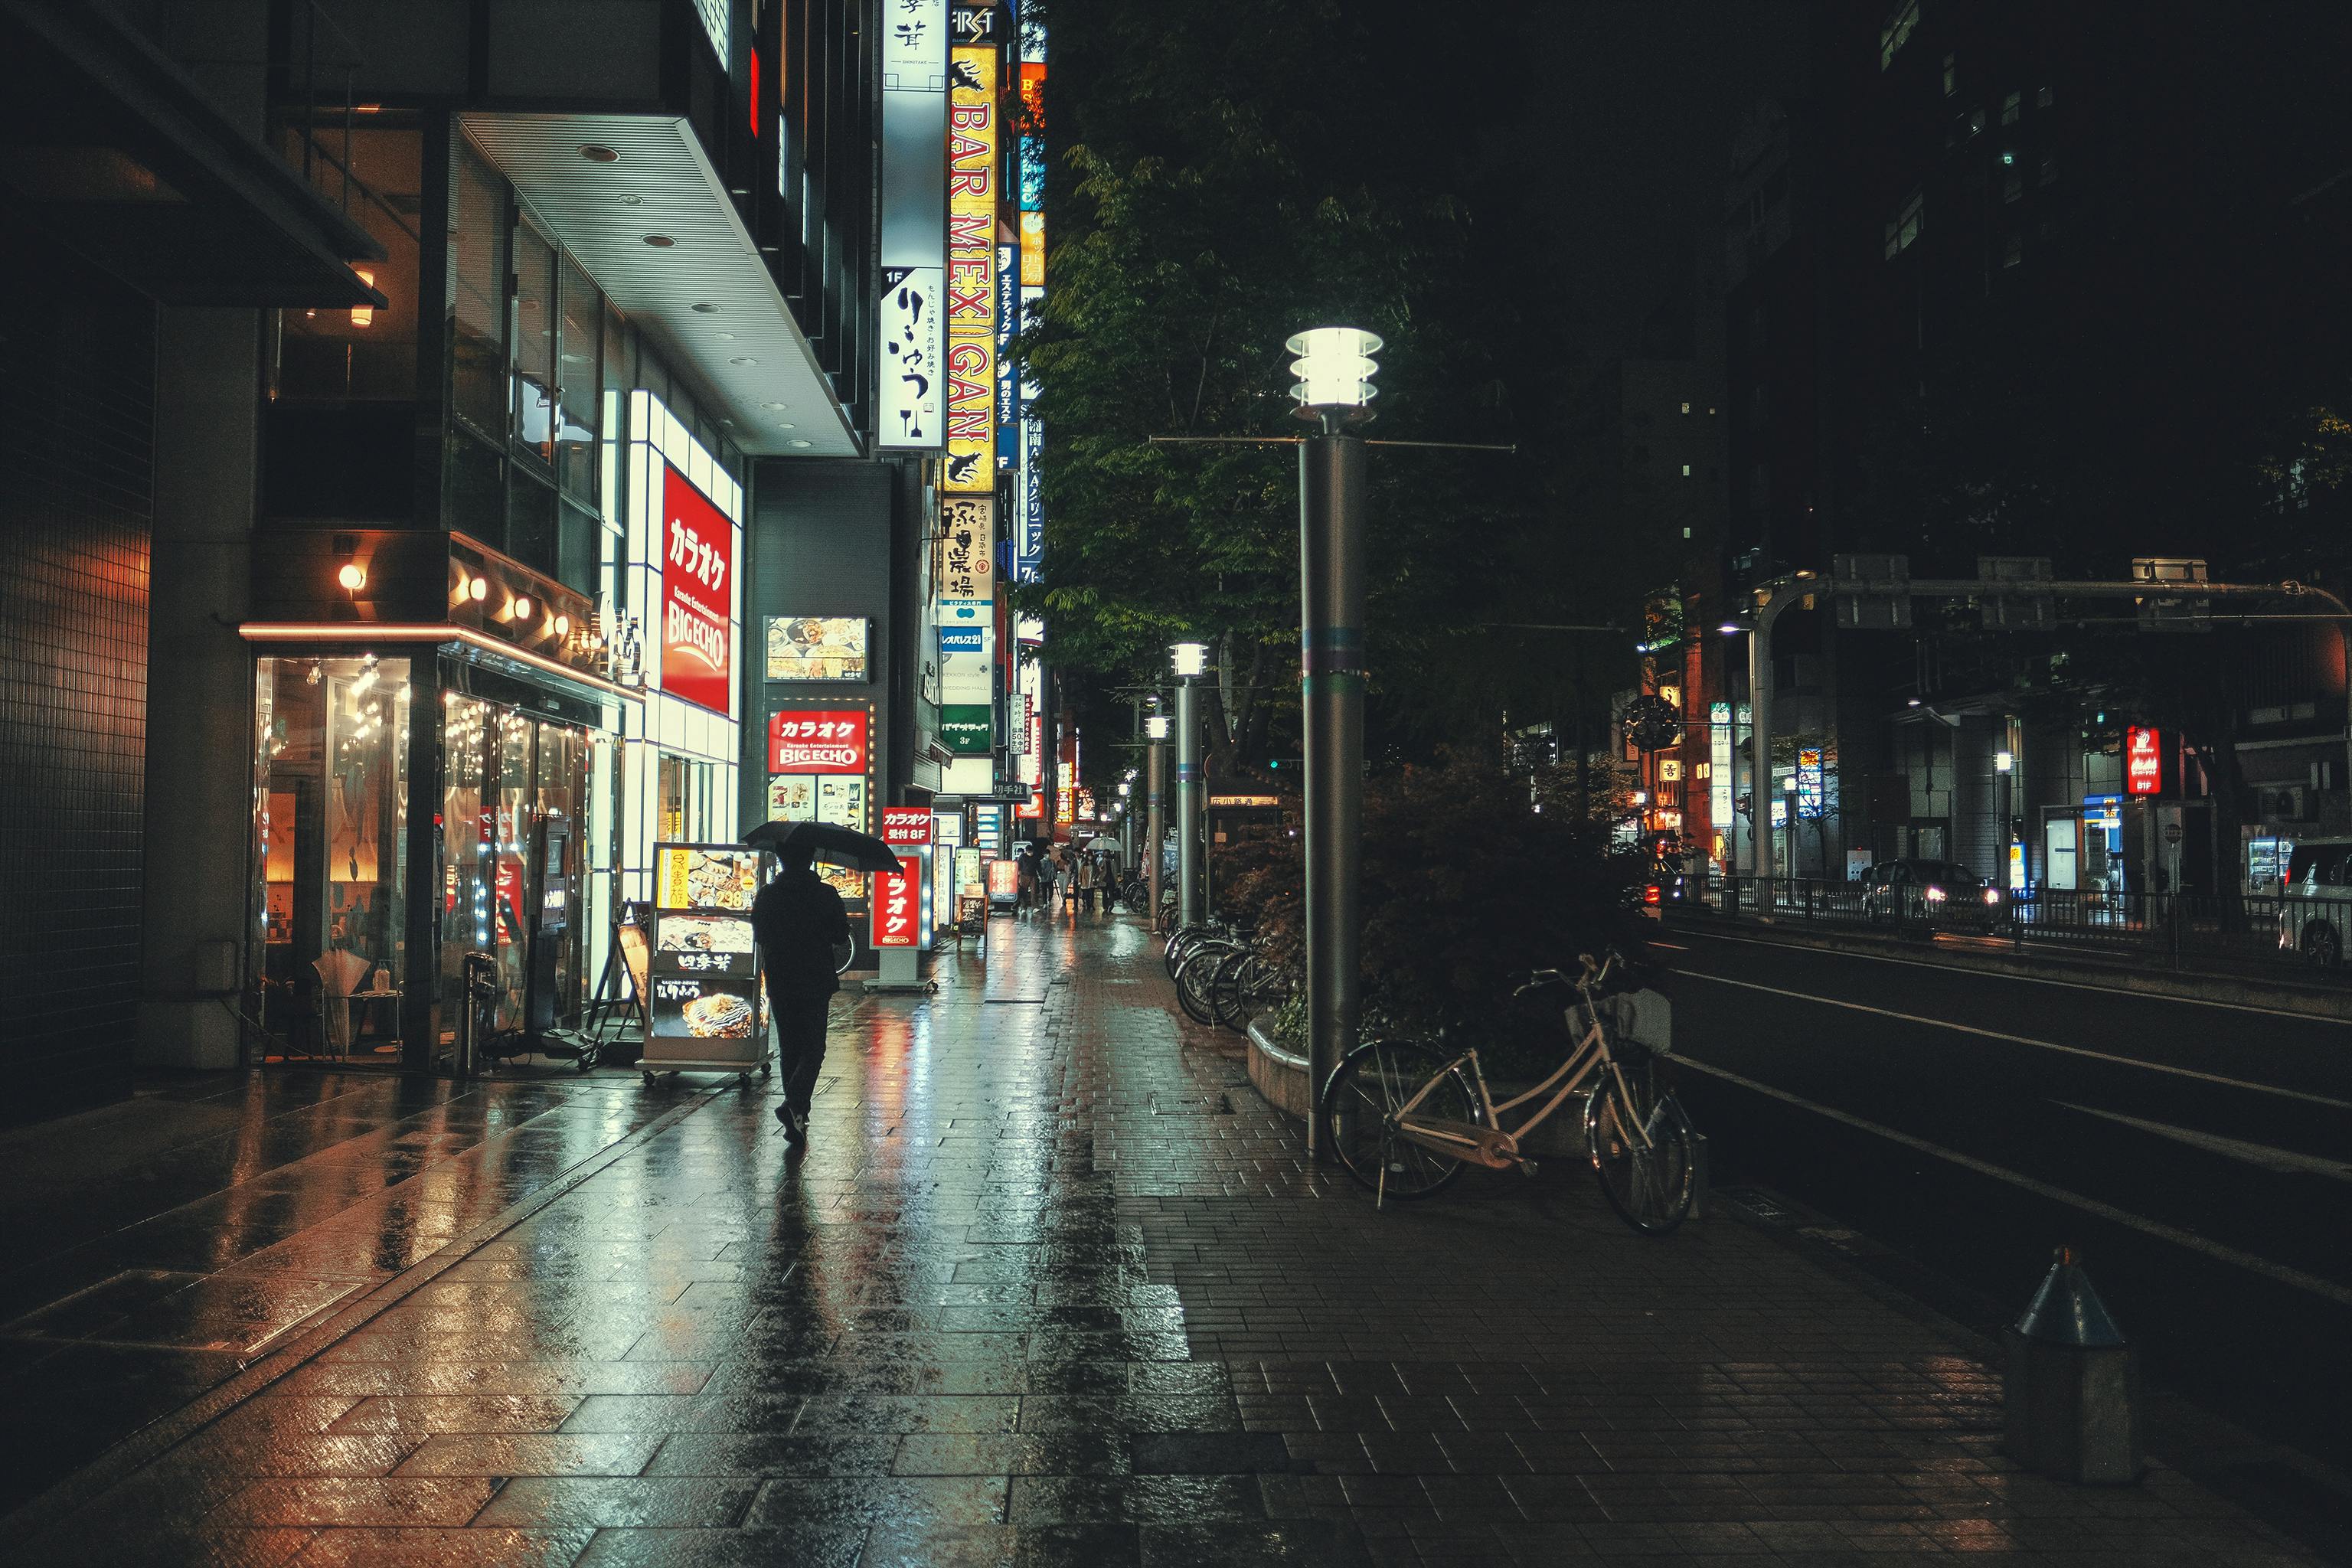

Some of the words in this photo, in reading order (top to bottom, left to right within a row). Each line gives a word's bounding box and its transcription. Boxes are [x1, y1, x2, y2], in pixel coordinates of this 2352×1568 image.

[949, 102, 991, 199] BAR
[887, 272, 903, 283] 1F
[1000, 380, 1011, 423] 男のエステ
[668, 518, 725, 591] カラオケ
[674, 585, 691, 606] Karaoke
[691, 595, 719, 624] Entertainment
[668, 599, 693, 645] BIG
[693, 621, 724, 668] ECHO
[781, 721, 855, 738] カラオケ
[960, 736, 970, 745] 3F
[779, 749, 812, 765] BIG
[812, 750, 858, 765] ECHO
[884, 813, 930, 825] カラオケ
[888, 829, 908, 840] 受付
[910, 829, 926, 840] 8F
[671, 854, 685, 905] 鳥貴族
[715, 890, 743, 908] 298
[886, 859, 907, 933] ラオケ
[678, 953, 732, 972] 四季茸
